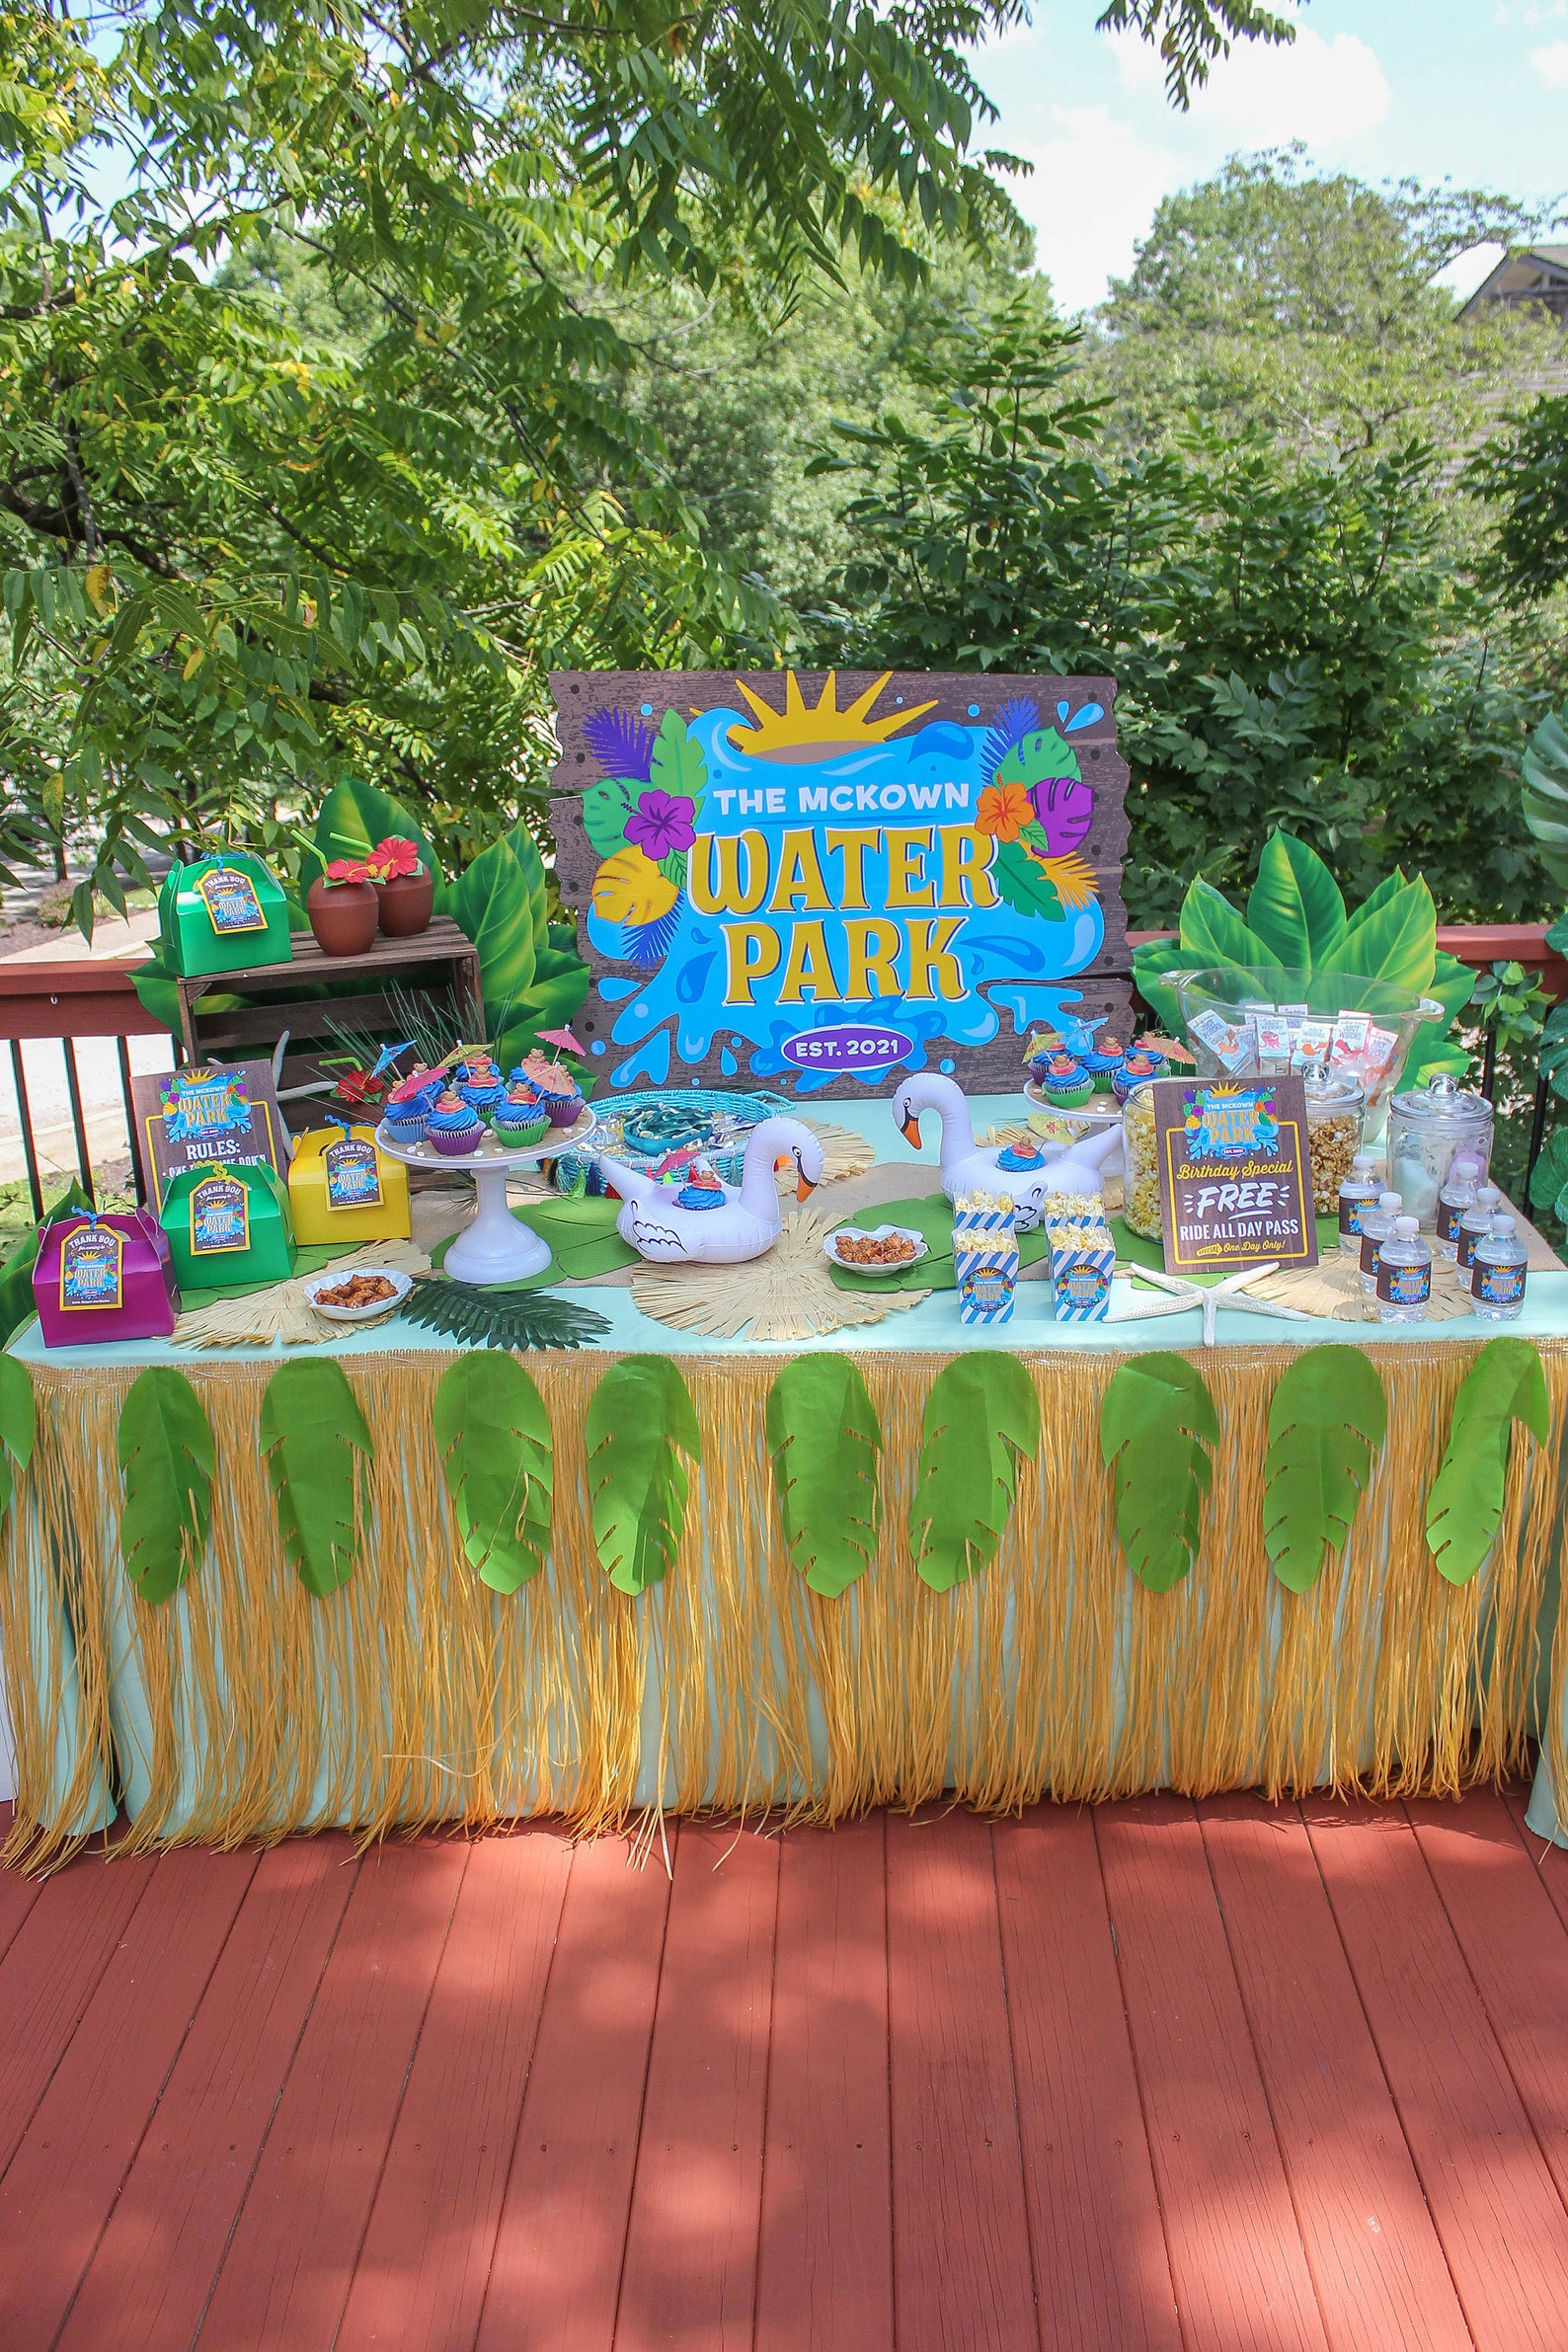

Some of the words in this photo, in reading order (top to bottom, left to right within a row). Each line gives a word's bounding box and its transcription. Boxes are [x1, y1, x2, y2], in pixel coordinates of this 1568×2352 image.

[713, 787, 786, 816] THE
[799, 782, 971, 813] MCKOWN
[686, 822, 1004, 916] WATER
[204, 876, 229, 888] THANK
[229, 875, 246, 885] YOU
[718, 914, 975, 1007] PARK
[795, 1040, 842, 1058] EST.
[845, 1038, 901, 1057] 2021
[178, 1092, 233, 1113] WATER
[186, 1108, 230, 1128] PARK
[1203, 1109, 1261, 1128] WATER
[1210, 1127, 1256, 1144] PARK
[185, 1138, 242, 1161] RULES:
[329, 1144, 355, 1157] THANK
[356, 1144, 373, 1154] YOU
[1176, 1163, 1240, 1180] Birthday
[1241, 1159, 1294, 1179] Special
[338, 1172, 366, 1183] WATER
[196, 1185, 223, 1199] THANK
[225, 1185, 242, 1196] YOU
[342, 1181, 365, 1190] PARK
[1196, 1182, 1279, 1219] FREE
[204, 1215, 234, 1225] WATER
[206, 1223, 231, 1233] PARK
[1180, 1224, 1211, 1241] RIDE
[1213, 1222, 1235, 1239] ALL
[1238, 1220, 1263, 1238] DAY
[1265, 1218, 1299, 1236] PASS
[68, 1234, 98, 1248] THANK
[99, 1234, 117, 1247] YOU
[1223, 1242, 1240, 1253] One
[1241, 1241, 1261, 1253] Day
[1262, 1239, 1287, 1252] Only!
[74, 1268, 107, 1279] WATER
[77, 1278, 104, 1288] PARK
[976, 1293, 1001, 1301] PARK
